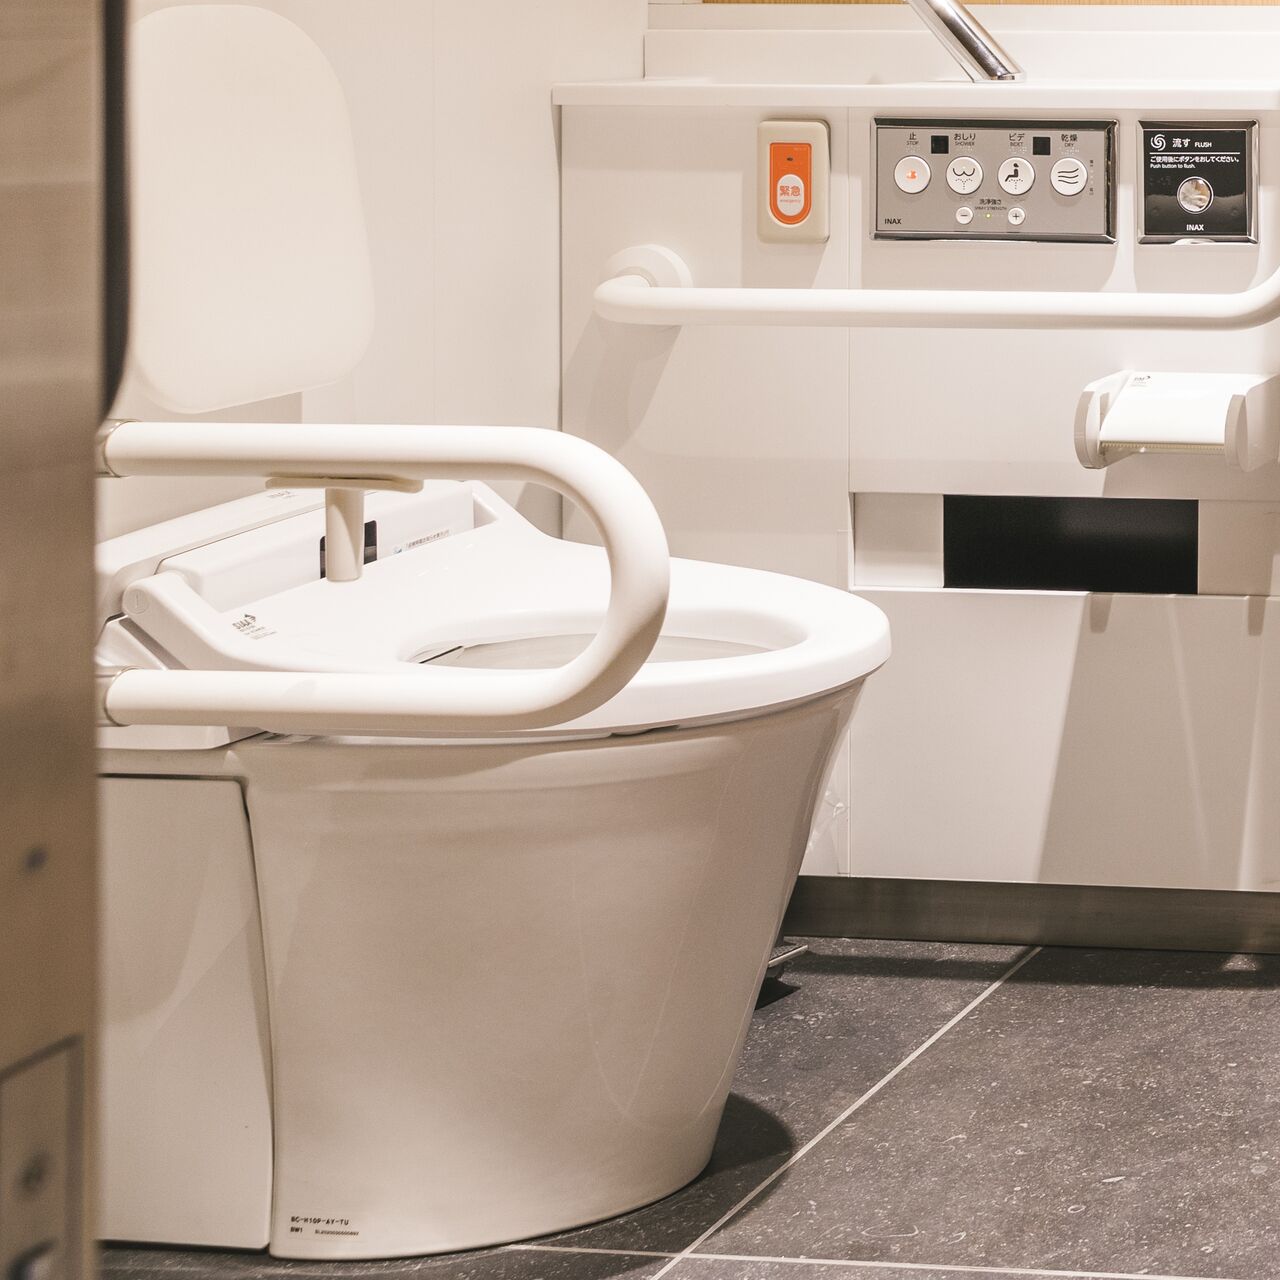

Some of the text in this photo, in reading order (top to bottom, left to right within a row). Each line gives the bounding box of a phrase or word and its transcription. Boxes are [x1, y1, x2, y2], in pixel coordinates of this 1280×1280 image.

[909, 132, 917, 140] 止
[954, 133, 976, 141] おしり
[1009, 133, 1025, 141] ビデ
[1061, 133, 1078, 142] 乾燥
[1172, 138, 1191, 148] 流す
[780, 185, 801, 197] 緊急
